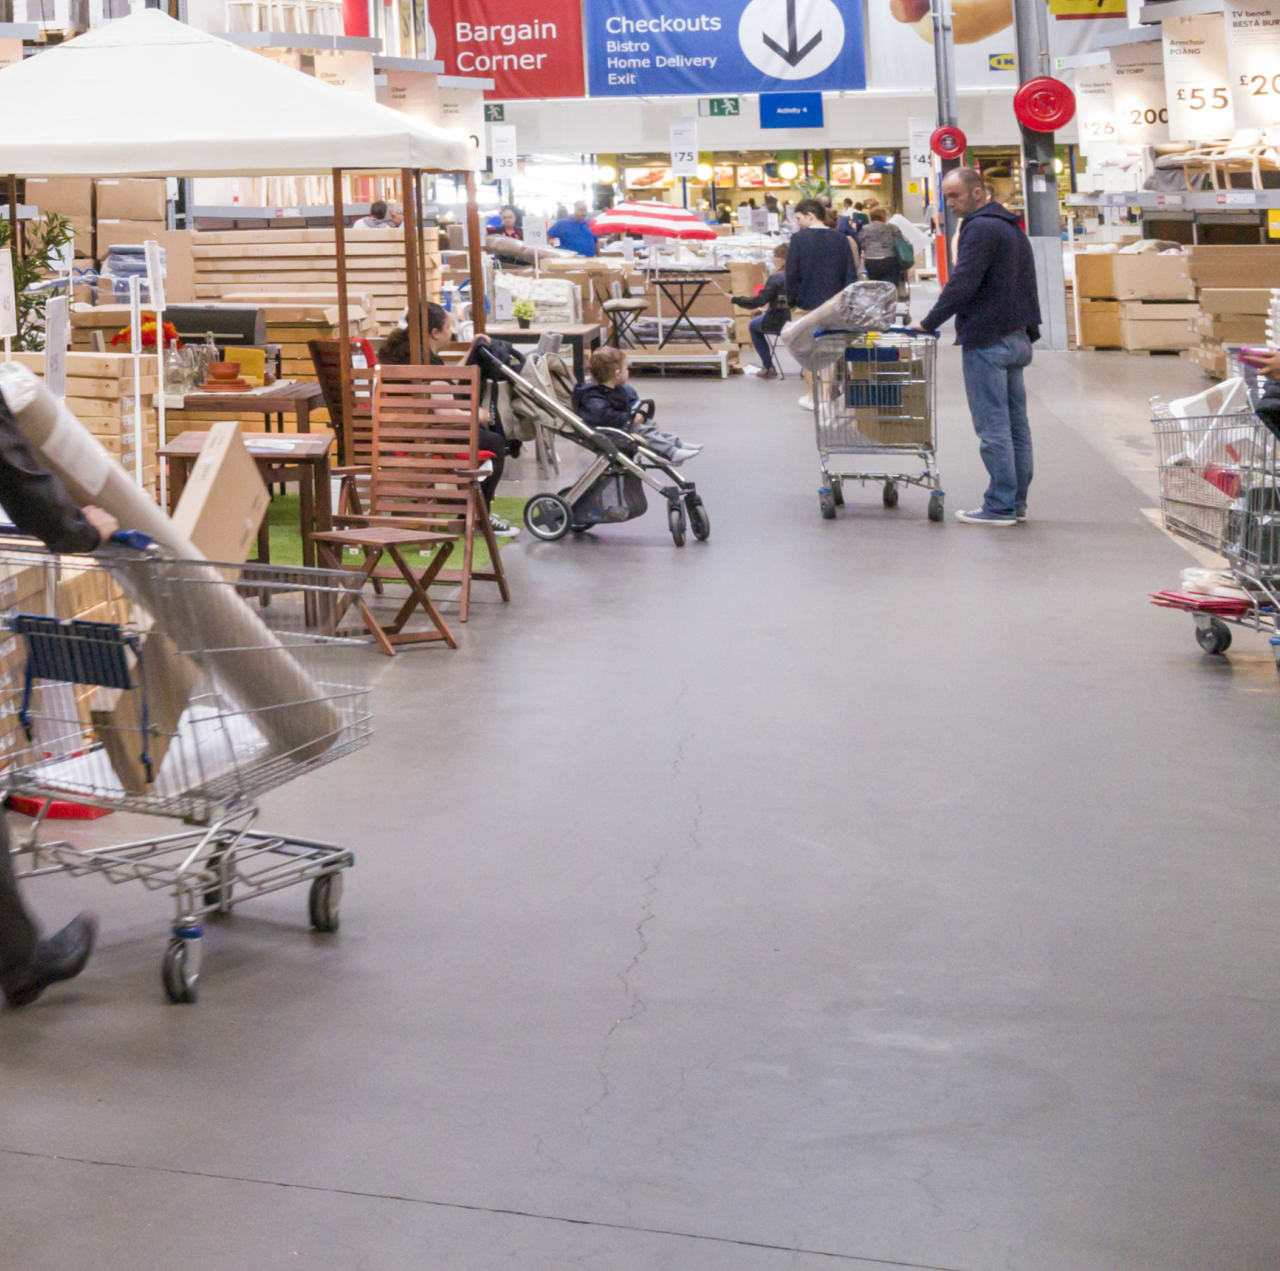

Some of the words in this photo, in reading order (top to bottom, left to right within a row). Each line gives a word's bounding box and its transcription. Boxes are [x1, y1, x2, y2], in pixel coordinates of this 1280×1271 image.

[606, 14, 722, 33] Checkouts
[456, 19, 557, 45] Bargain
[607, 40, 650, 53] Bistro
[457, 51, 547, 72] Corner
[607, 56, 650, 68] Home
[656, 55, 717, 69] Delivery
[608, 73, 636, 85] Exit
[1177, 87, 1229, 111] £55
[776, 107, 801, 115] Activity
